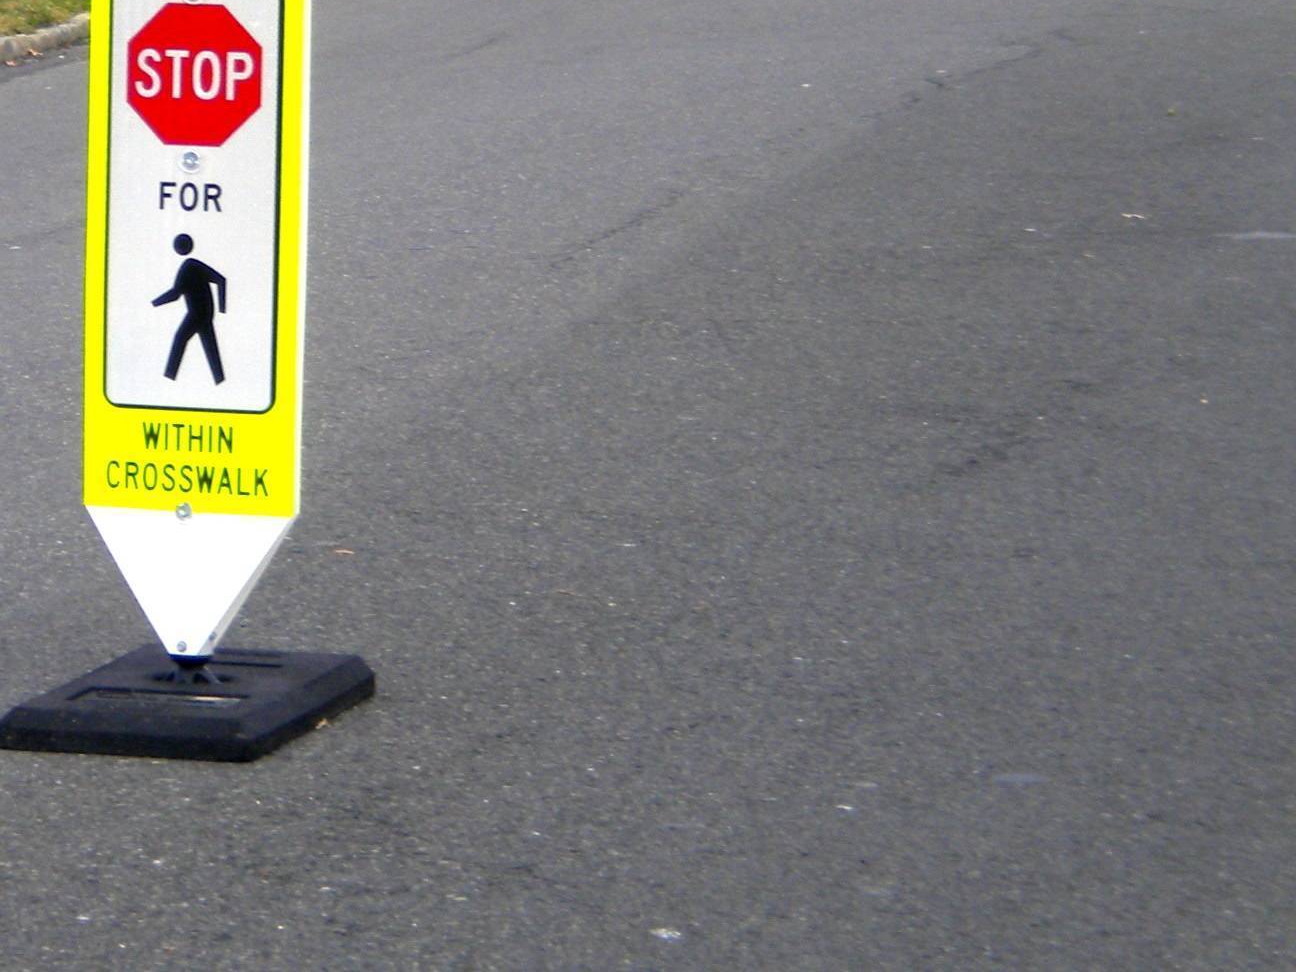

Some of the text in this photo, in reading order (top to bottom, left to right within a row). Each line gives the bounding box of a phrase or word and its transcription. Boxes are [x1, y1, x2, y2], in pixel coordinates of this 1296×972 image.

[134, 48, 254, 101] STOP
[158, 181, 223, 213] FOR
[142, 421, 234, 454] WITHIN
[106, 460, 269, 497] CROSSWALK
